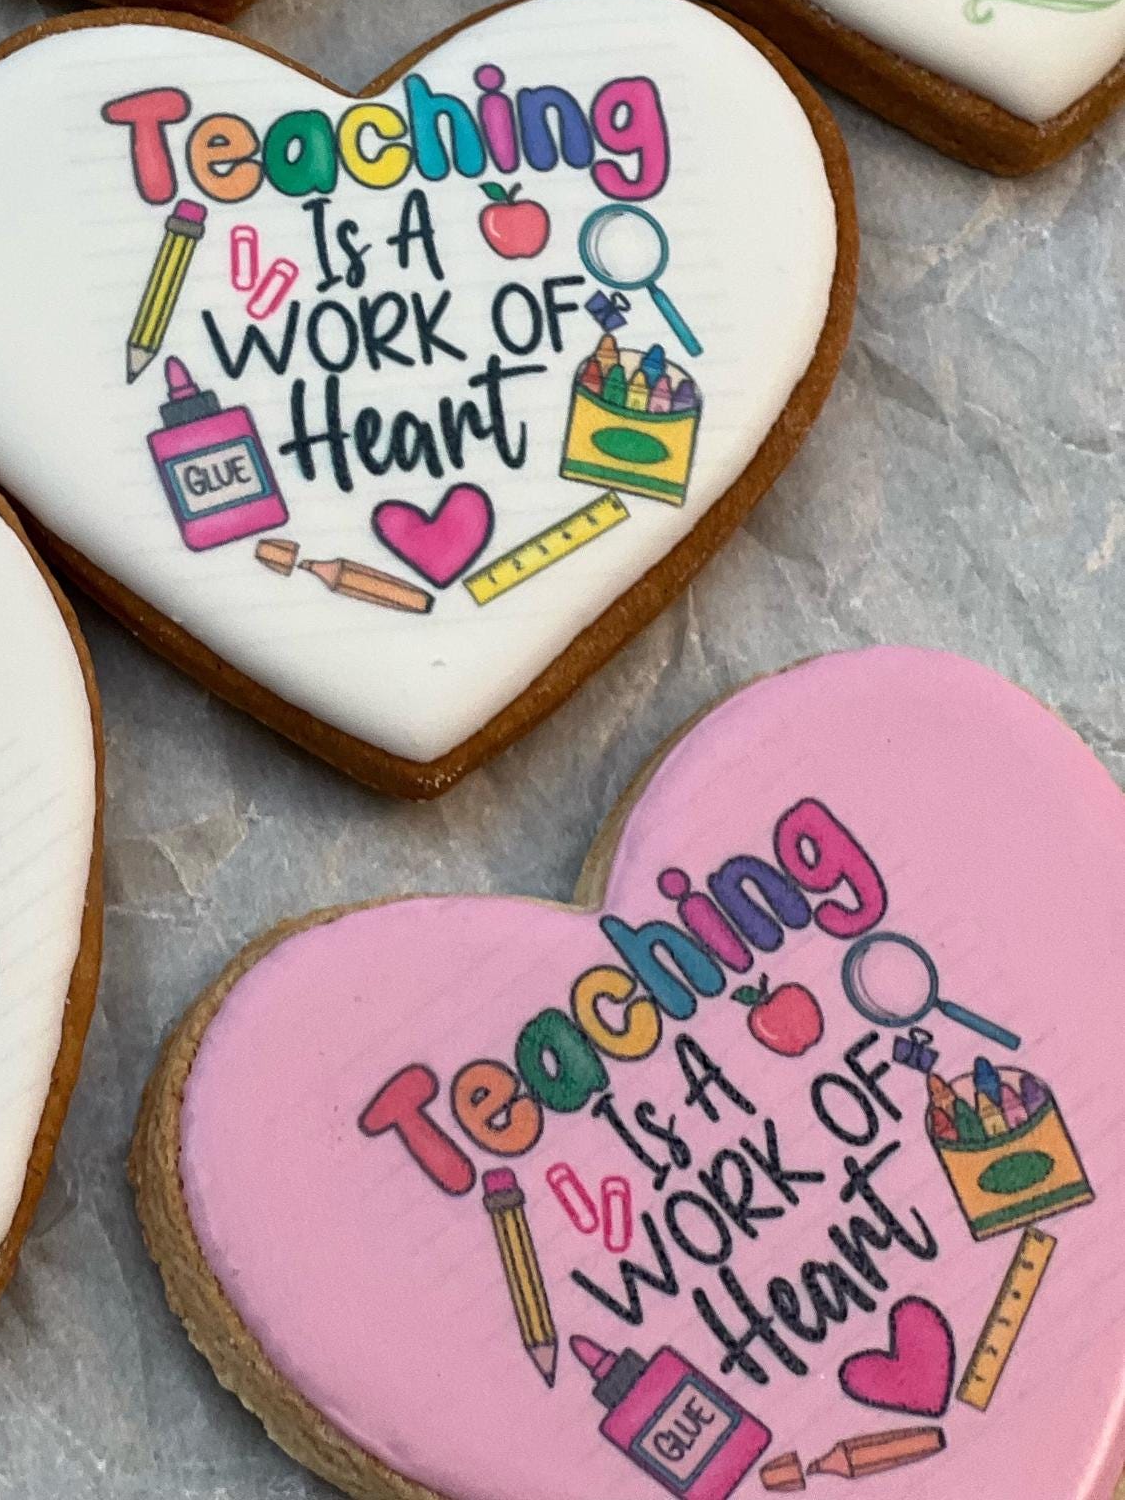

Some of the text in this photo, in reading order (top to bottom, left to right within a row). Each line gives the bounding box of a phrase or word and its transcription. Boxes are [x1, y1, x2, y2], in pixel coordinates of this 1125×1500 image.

[101, 63, 671, 205] Teaching
[302, 188, 445, 293] Is A
[201, 275, 587, 380] WORK OF
[183, 455, 252, 497] GLUE
[279, 355, 548, 494] Heart
[357, 797, 888, 1196] Teaching
[572, 1119, 827, 1326] WORK
[809, 1032, 903, 1146] OF
[591, 1033, 758, 1191] Is A
[692, 1141, 939, 1385] Heart
[653, 1395, 715, 1462] GLUE
